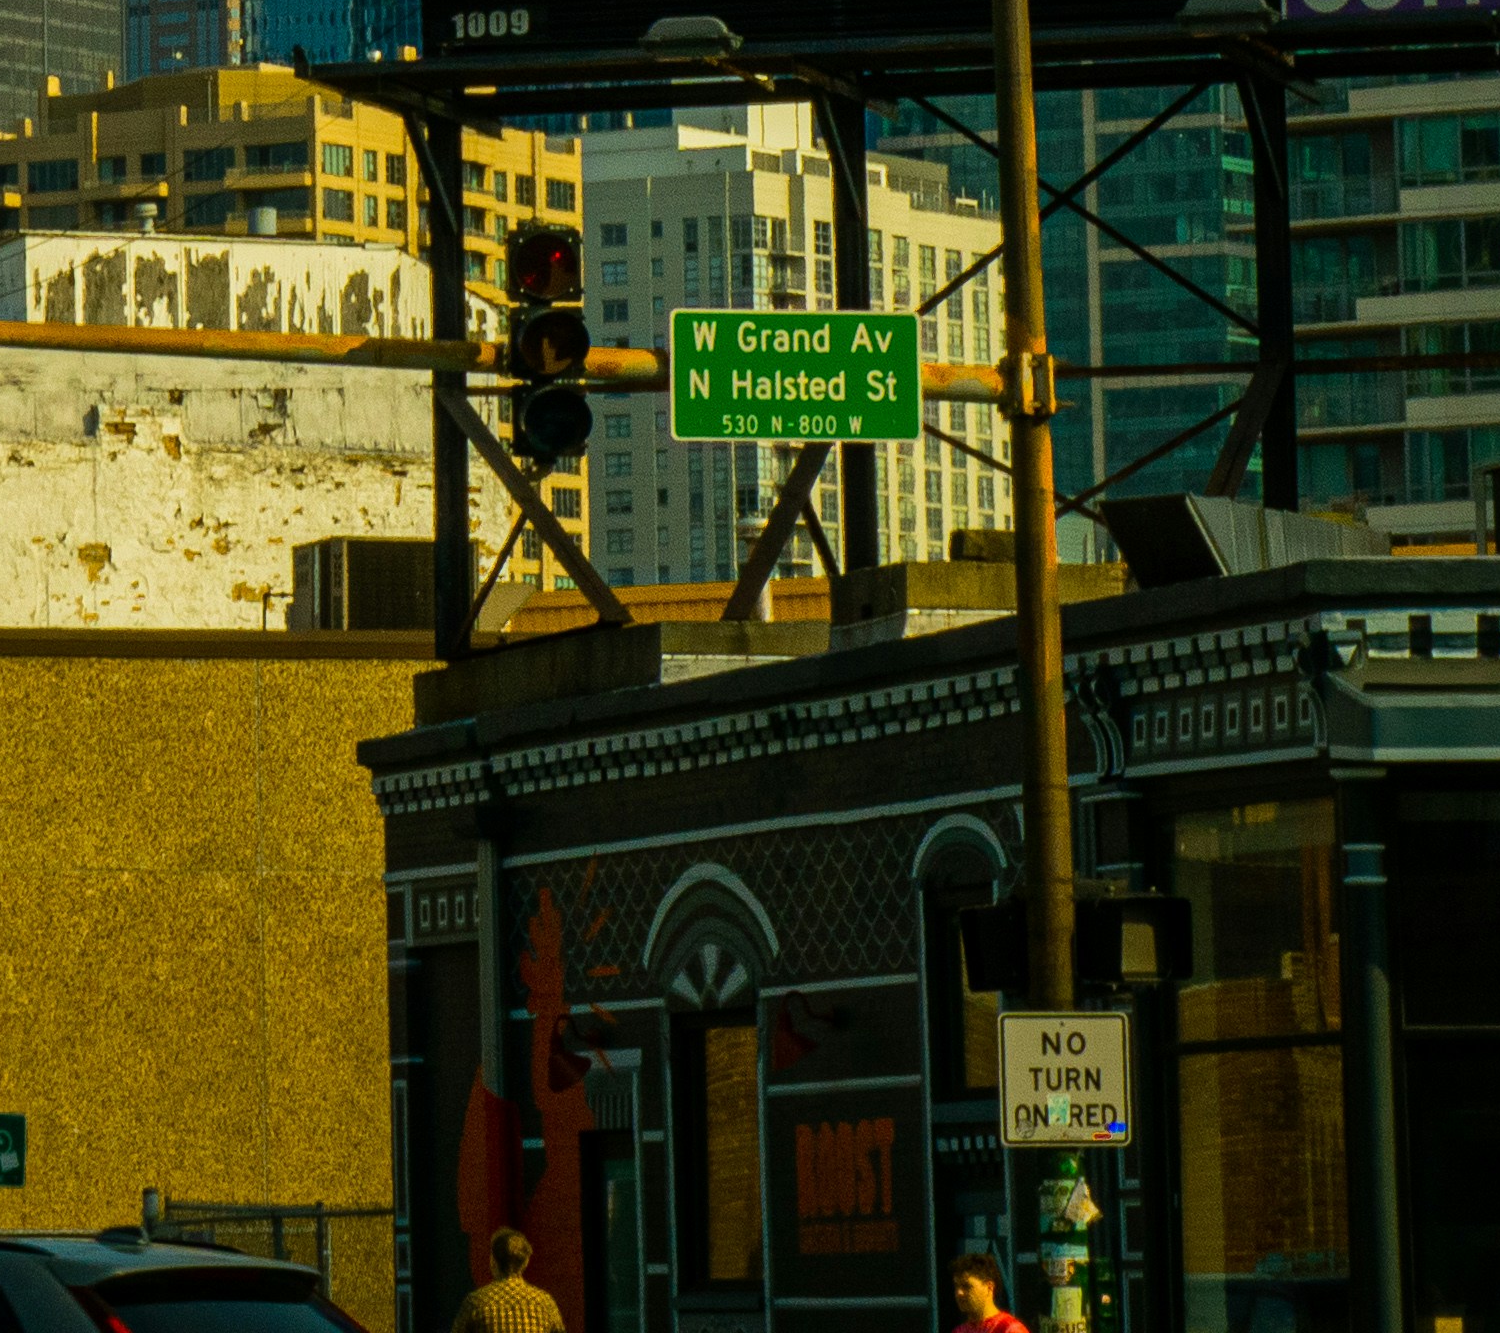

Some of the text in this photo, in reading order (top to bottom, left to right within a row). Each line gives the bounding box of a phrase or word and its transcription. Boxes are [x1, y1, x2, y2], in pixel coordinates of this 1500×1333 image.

[451, 8, 531, 40] 1009
[692, 320, 893, 353] W Grand Av
[690, 369, 897, 401] N Halsted St
[721, 414, 758, 436] 530
[847, 414, 864, 436] W
[1041, 1030, 1087, 1056] NO
[1028, 1066, 1102, 1092] TURN
[1014, 1103, 1118, 1128] ON RED
